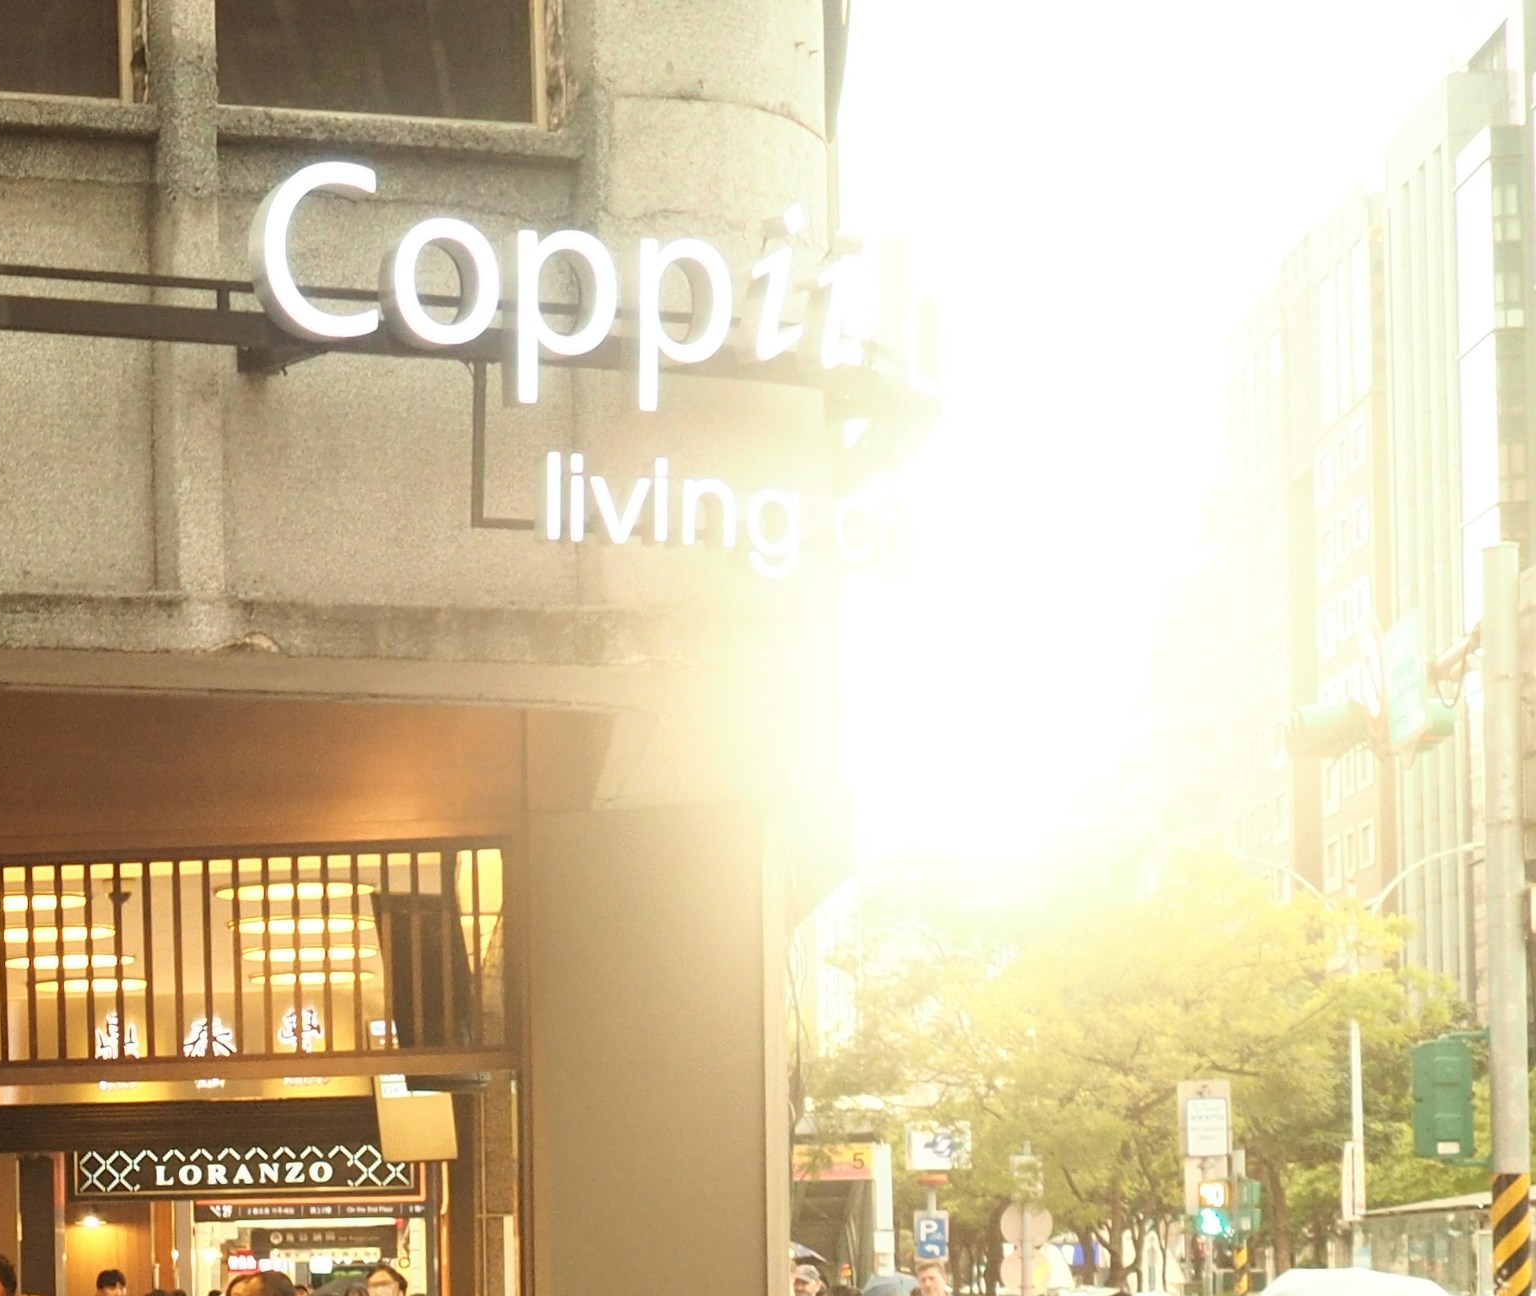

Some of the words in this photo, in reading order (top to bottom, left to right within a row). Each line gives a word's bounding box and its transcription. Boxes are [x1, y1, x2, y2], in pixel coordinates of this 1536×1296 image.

[546, 450, 801, 578] living
[852, 1152, 866, 1171] 5
[154, 1161, 334, 1187] LORANZO
[919, 1219, 939, 1242] P
